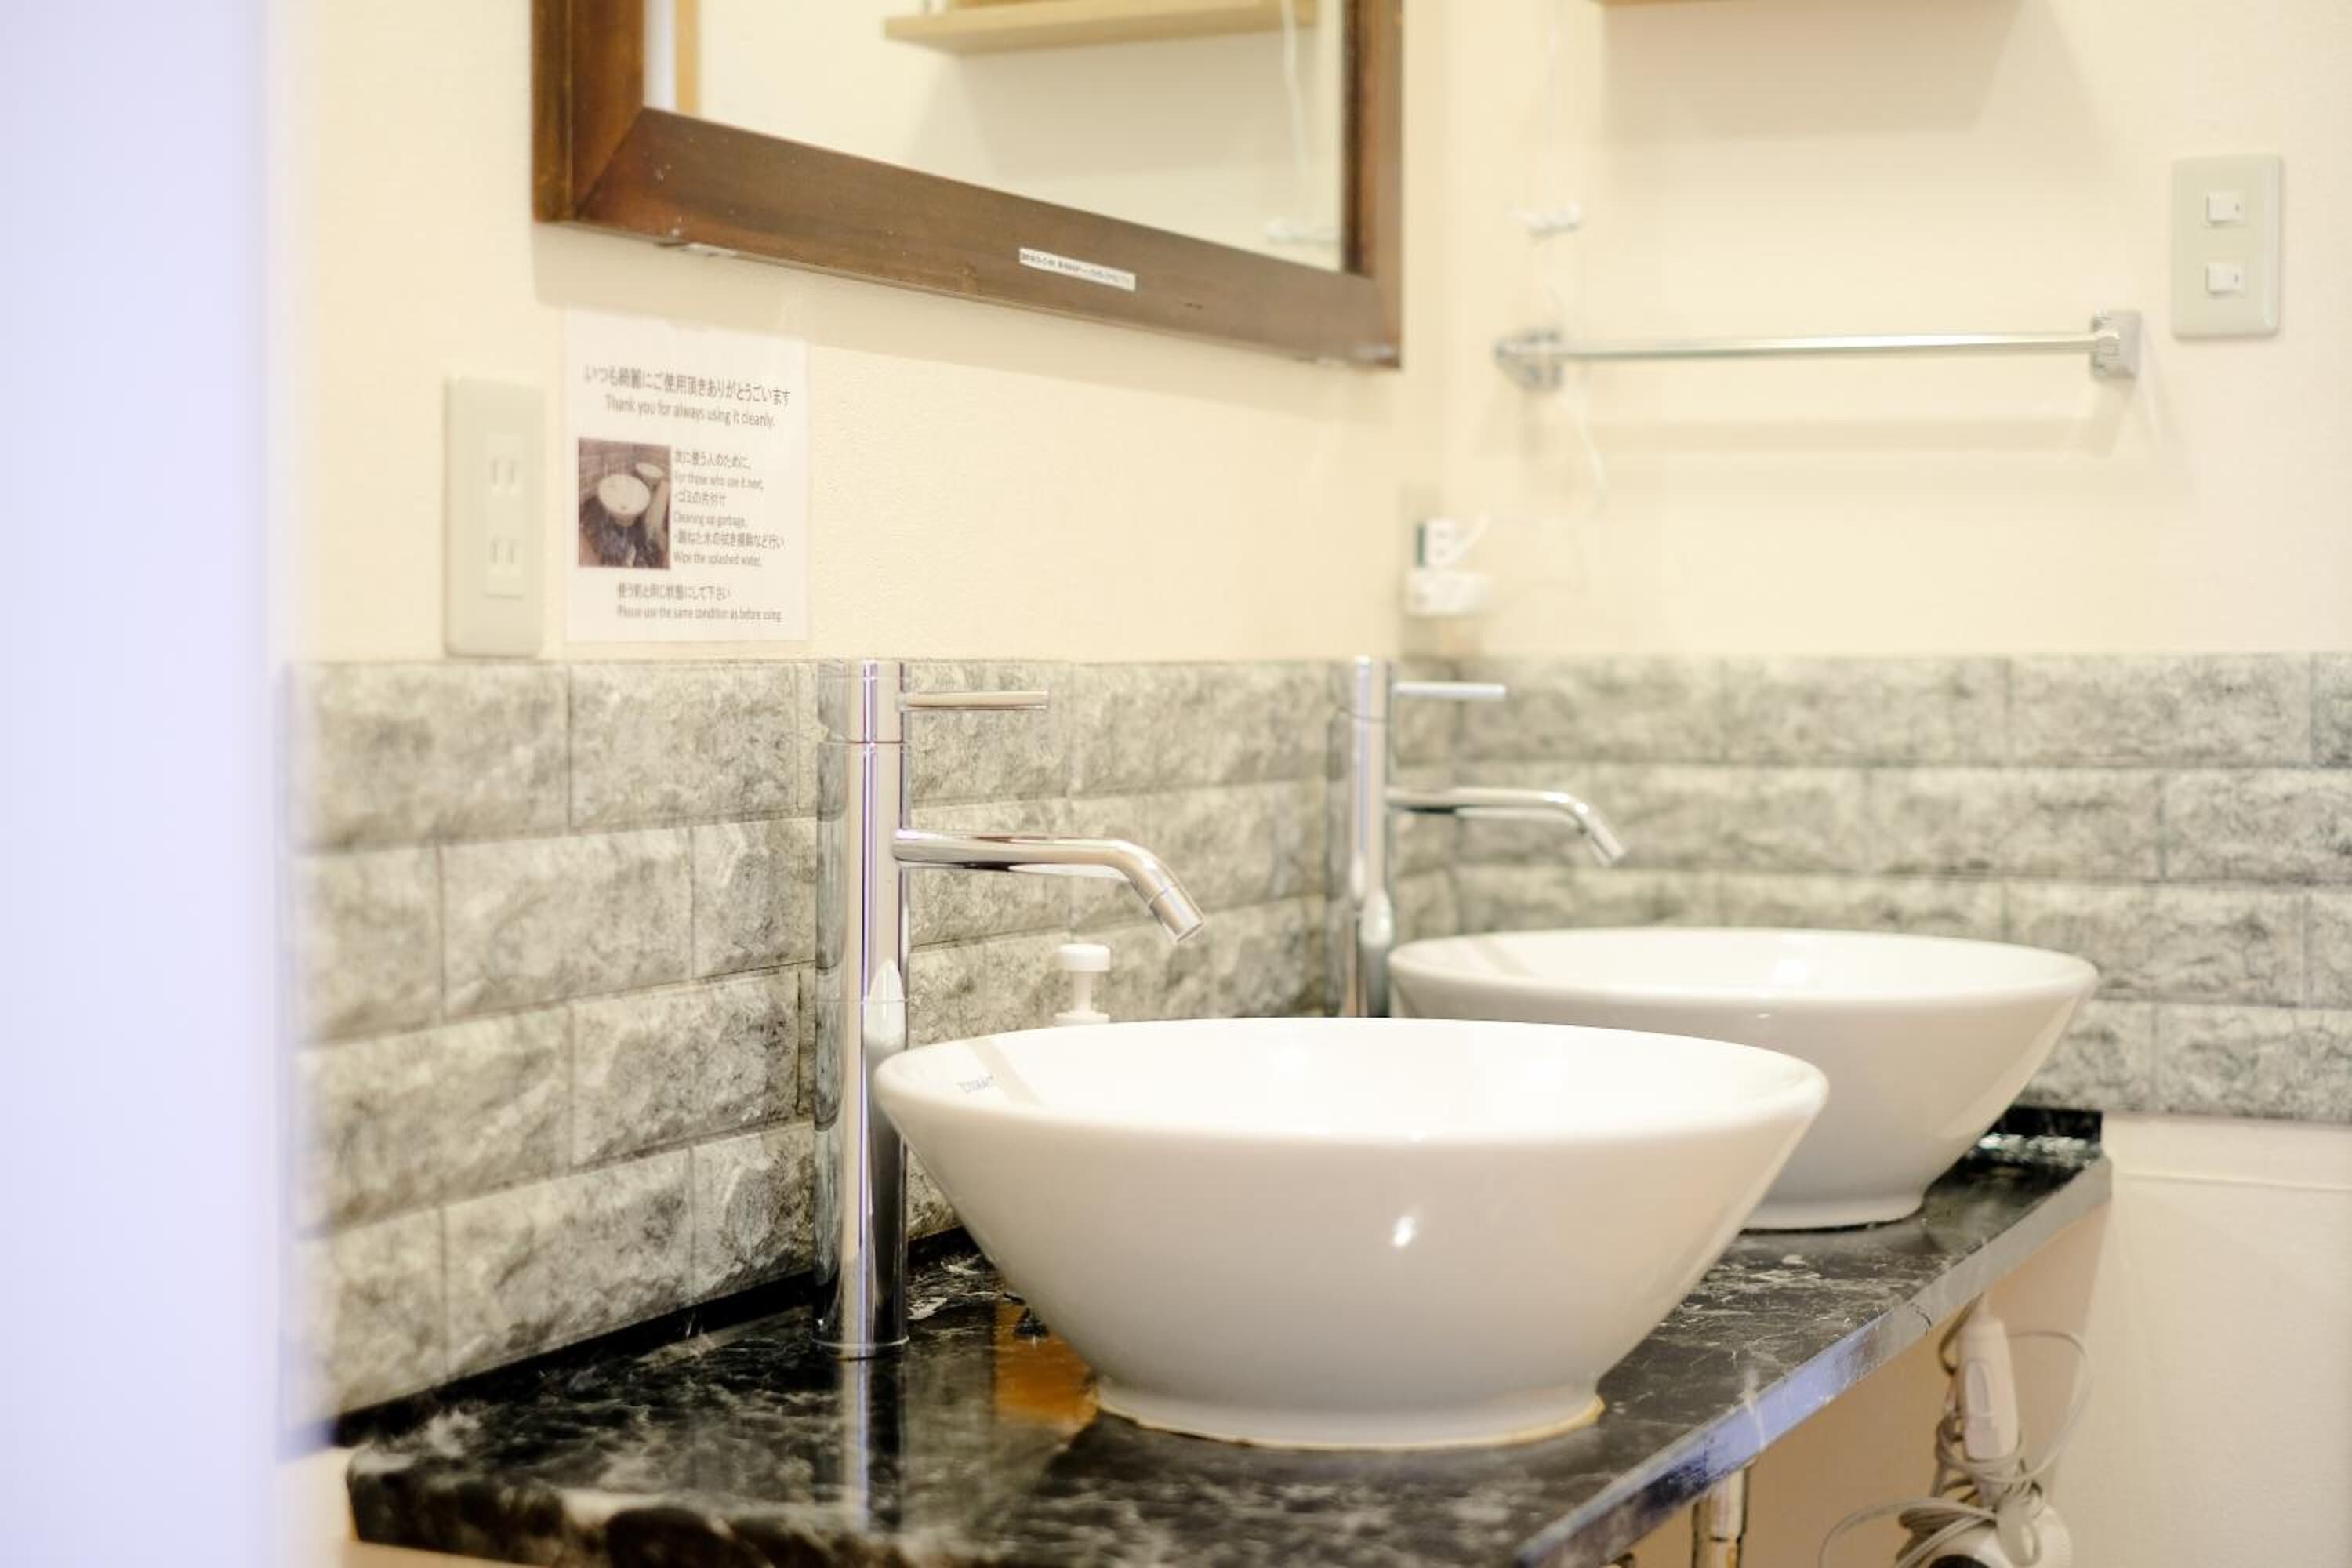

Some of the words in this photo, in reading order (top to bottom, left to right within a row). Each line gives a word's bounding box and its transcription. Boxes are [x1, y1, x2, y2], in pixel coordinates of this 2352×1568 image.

[604, 394, 635, 413] Thank
[637, 400, 655, 418] you
[657, 398, 672, 416] for
[673, 401, 705, 424] always
[706, 407, 731, 426] using
[732, 410, 739, 425] it
[741, 411, 776, 429] cleanly.
[688, 472, 707, 485] those
[710, 474, 724, 486] who
[726, 477, 739, 488] use
[673, 510, 704, 527] Cleaning
[673, 551, 691, 564] Wipe
[693, 552, 705, 564] the
[708, 554, 739, 565] splashed
[644, 608, 656, 619] use
[659, 605, 671, 619] the
[673, 608, 693, 619] same
[739, 607, 761, 620] before
